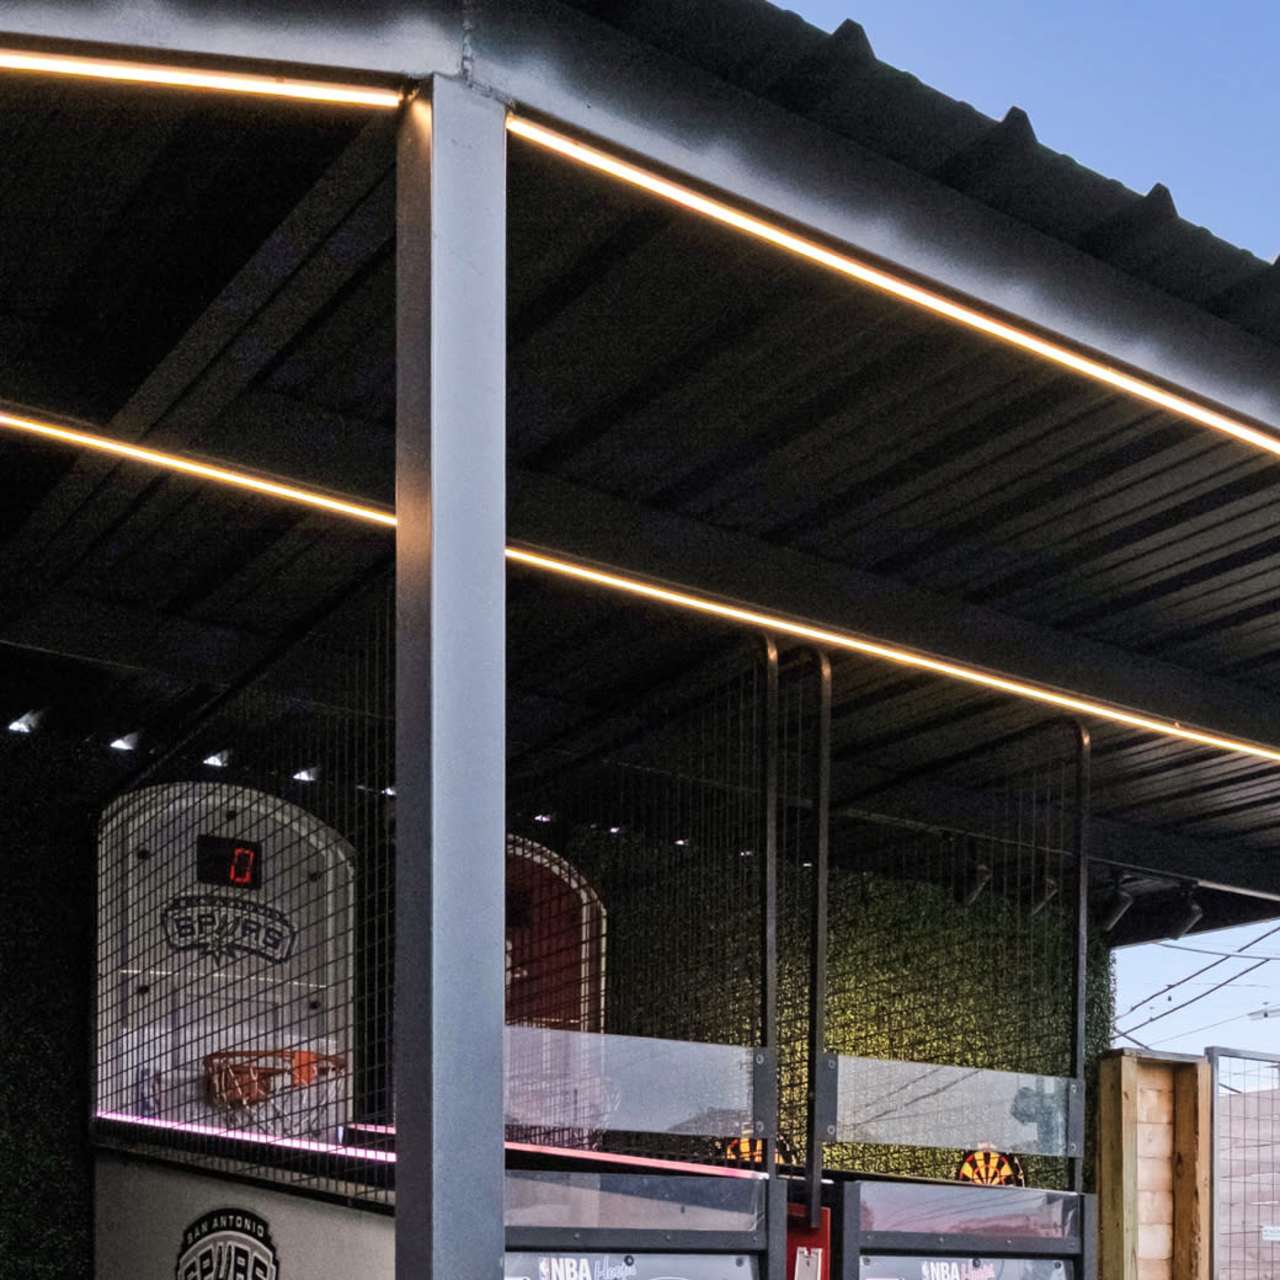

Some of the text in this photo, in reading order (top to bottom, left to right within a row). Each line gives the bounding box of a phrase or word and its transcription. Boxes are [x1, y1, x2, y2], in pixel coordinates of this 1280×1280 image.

[230, 848, 255, 883] 0
[176, 913, 283, 950] SPURS
[187, 1215, 265, 1243] SAN ANTONIO
